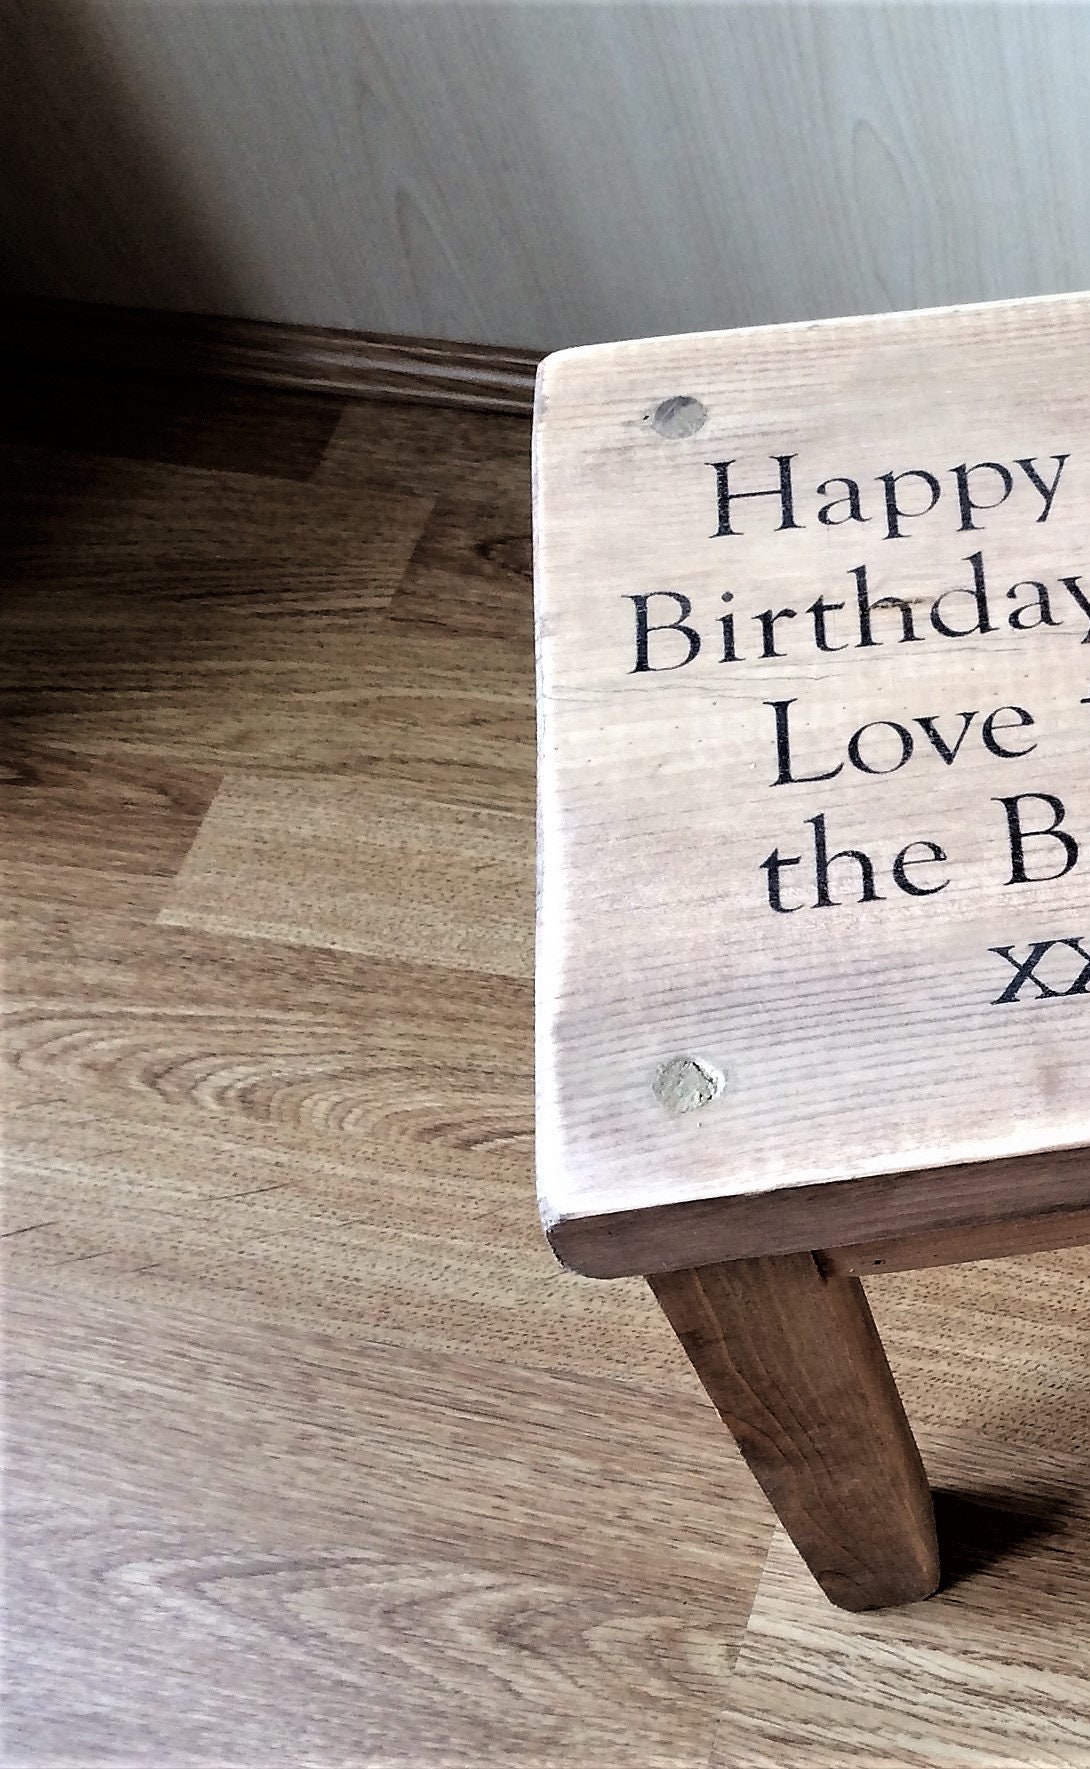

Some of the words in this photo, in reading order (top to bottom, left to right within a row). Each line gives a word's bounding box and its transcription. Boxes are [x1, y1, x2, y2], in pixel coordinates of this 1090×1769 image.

[705, 452, 1071, 540] Happy
[762, 697, 1038, 788] Love
[759, 811, 949, 915] the
